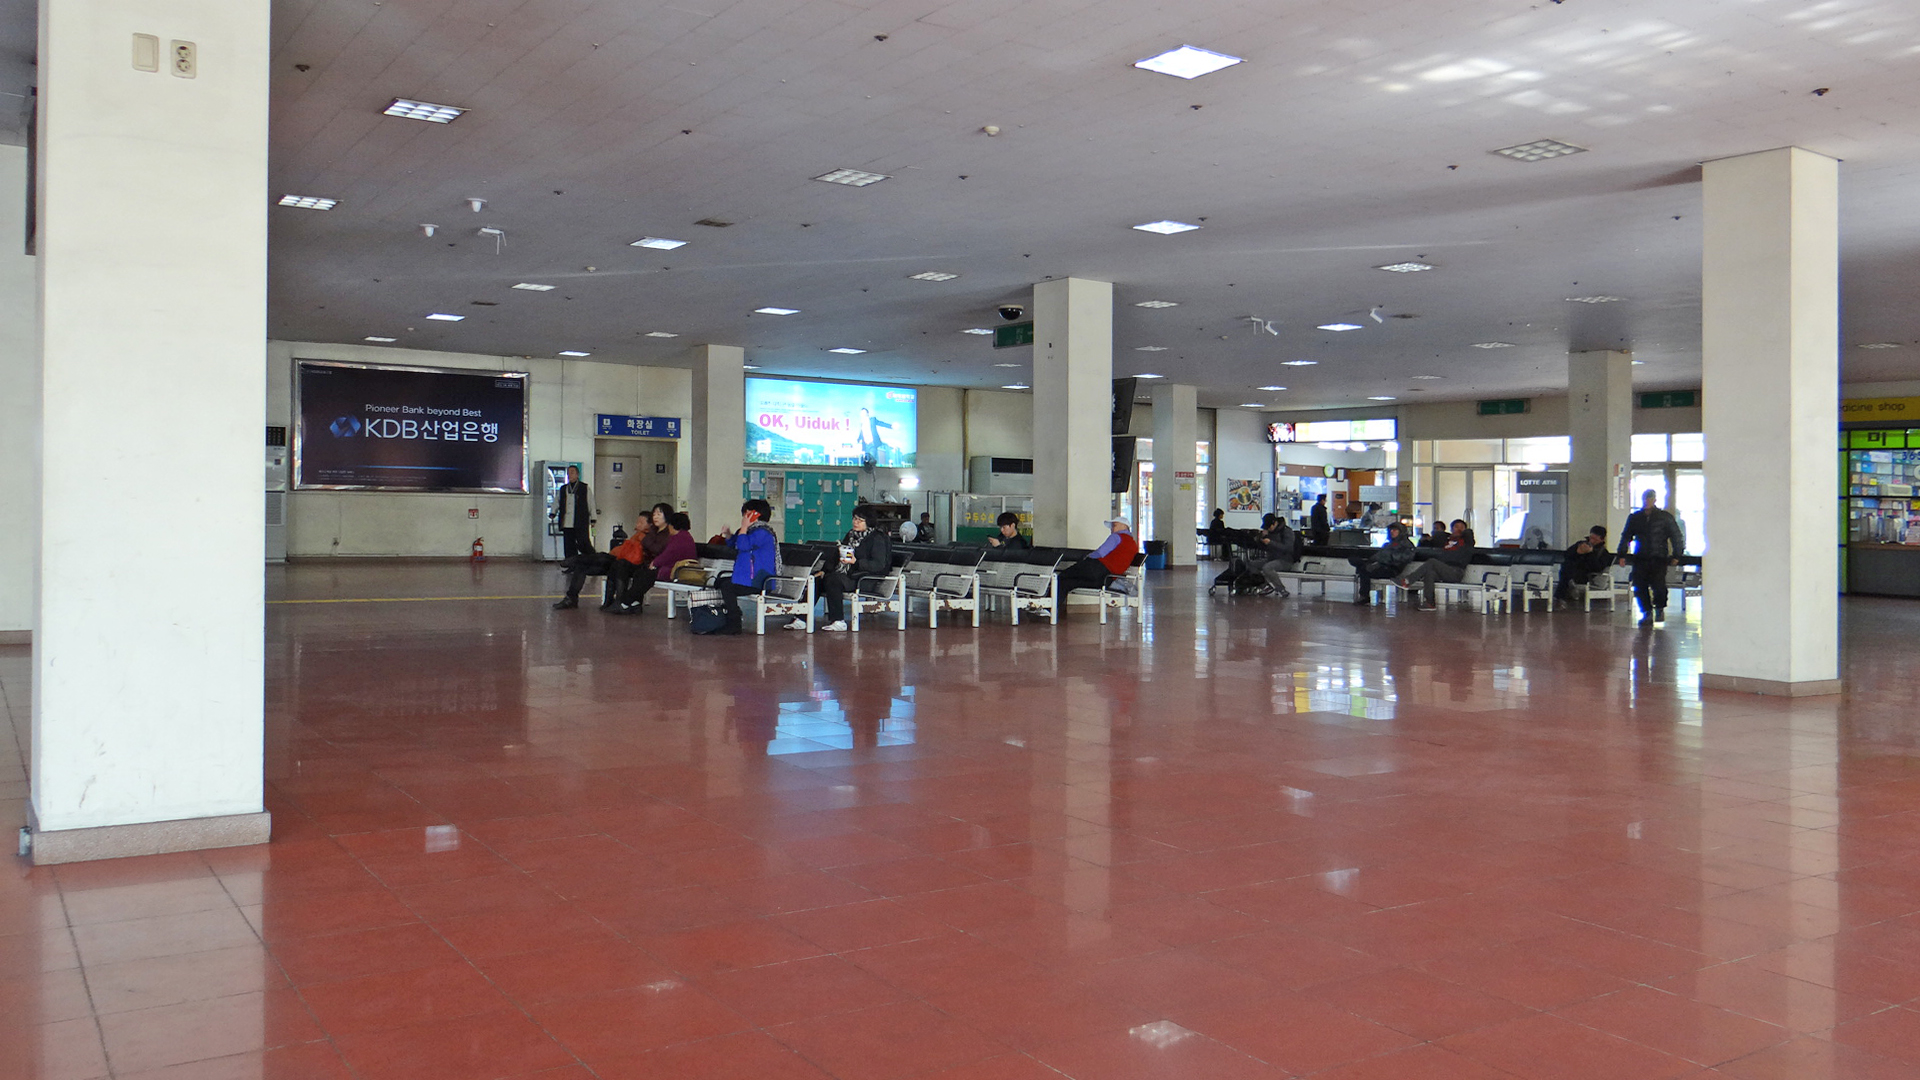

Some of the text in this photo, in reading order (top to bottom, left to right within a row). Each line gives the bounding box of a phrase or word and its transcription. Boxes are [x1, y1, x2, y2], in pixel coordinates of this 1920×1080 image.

[365, 403, 482, 418] Pioneer Bank beyond Best
[1841, 402, 1905, 412] dicine shop
[626, 418, 653, 430] 화장실
[759, 412, 790, 432] OK,
[794, 416, 841, 432] Uiduk
[365, 417, 499, 443] KDB산업은행
